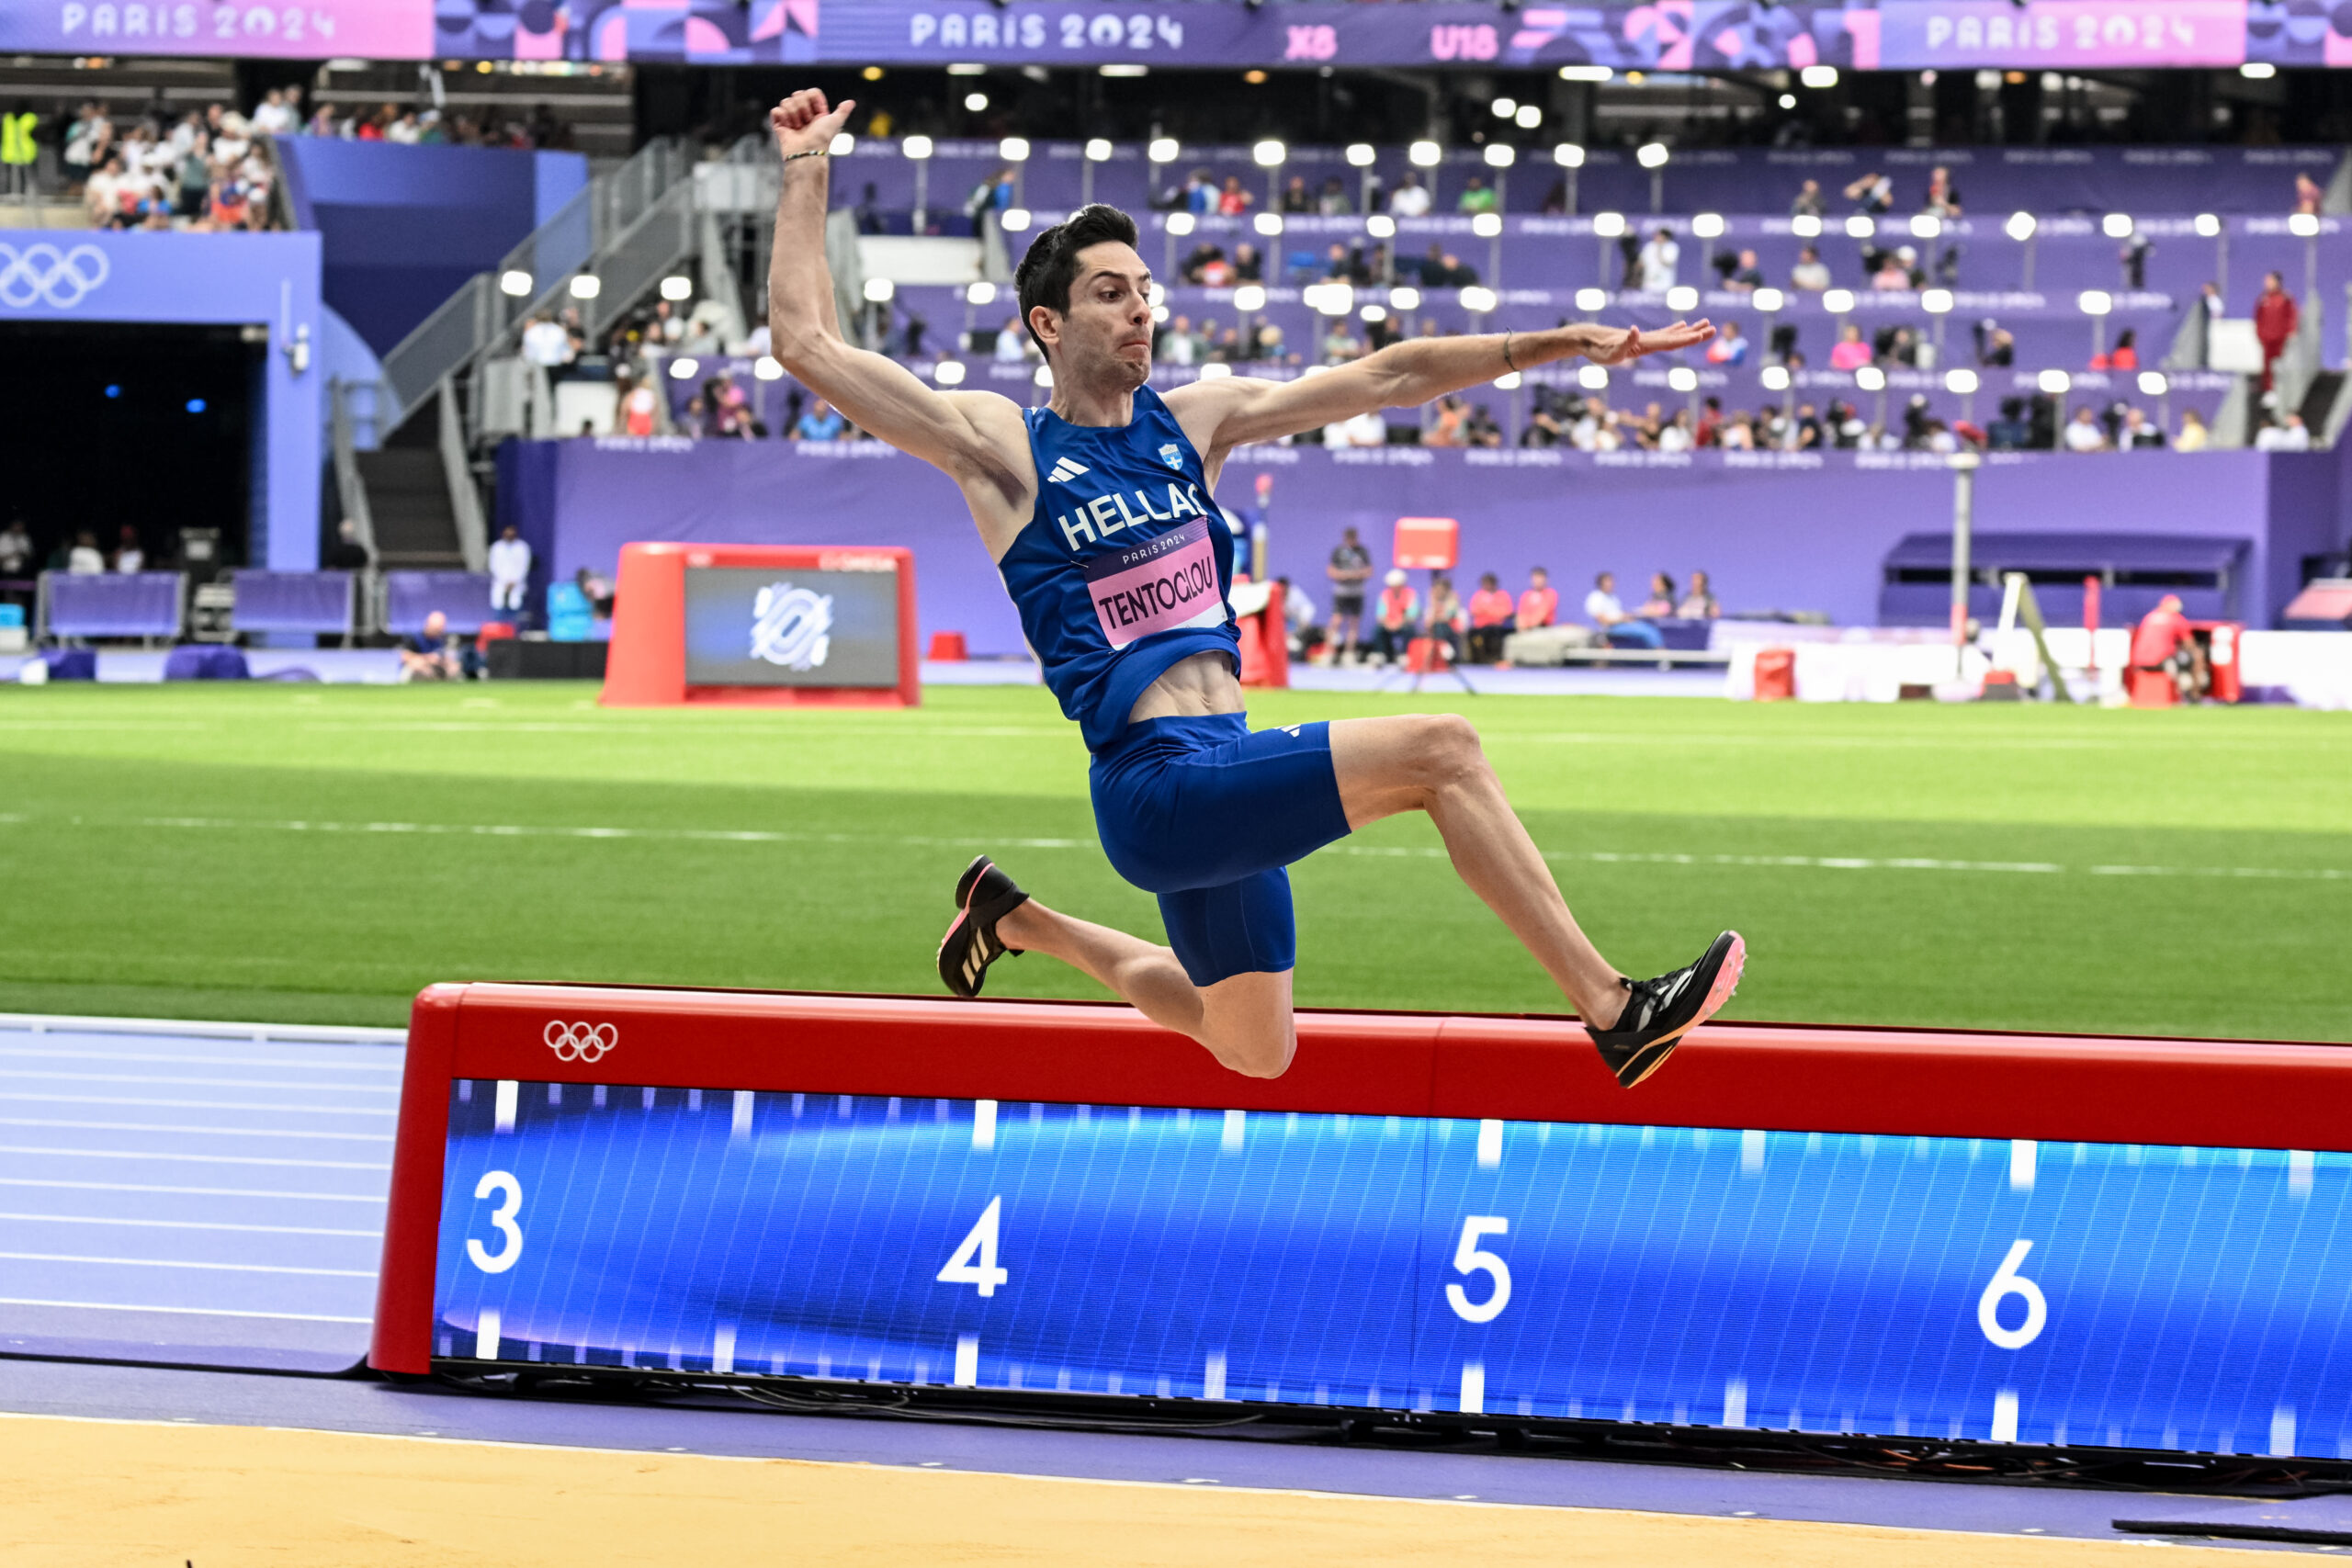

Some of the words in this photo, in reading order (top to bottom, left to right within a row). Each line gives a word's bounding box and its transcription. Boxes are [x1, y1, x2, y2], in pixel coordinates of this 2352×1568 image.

[62, 5, 198, 38] PARIS
[212, 6, 335, 40] 2024
[910, 13, 1046, 48] PARIS
[1059, 13, 1183, 49] 2024
[1927, 15, 2059, 50] PARIS
[2074, 15, 2196, 50] 2024
[1284, 24, 1338, 61] X8
[1430, 24, 1498, 61] U18
[1123, 544, 1159, 564] PARIS
[1160, 533, 1185, 550] 2024
[1099, 556, 1213, 629] TENTOGLOU
[466, 1170, 523, 1274] 3
[936, 1195, 1008, 1297] 4
[1445, 1215, 1511, 1323] 5
[1978, 1239, 2047, 1349] 6
